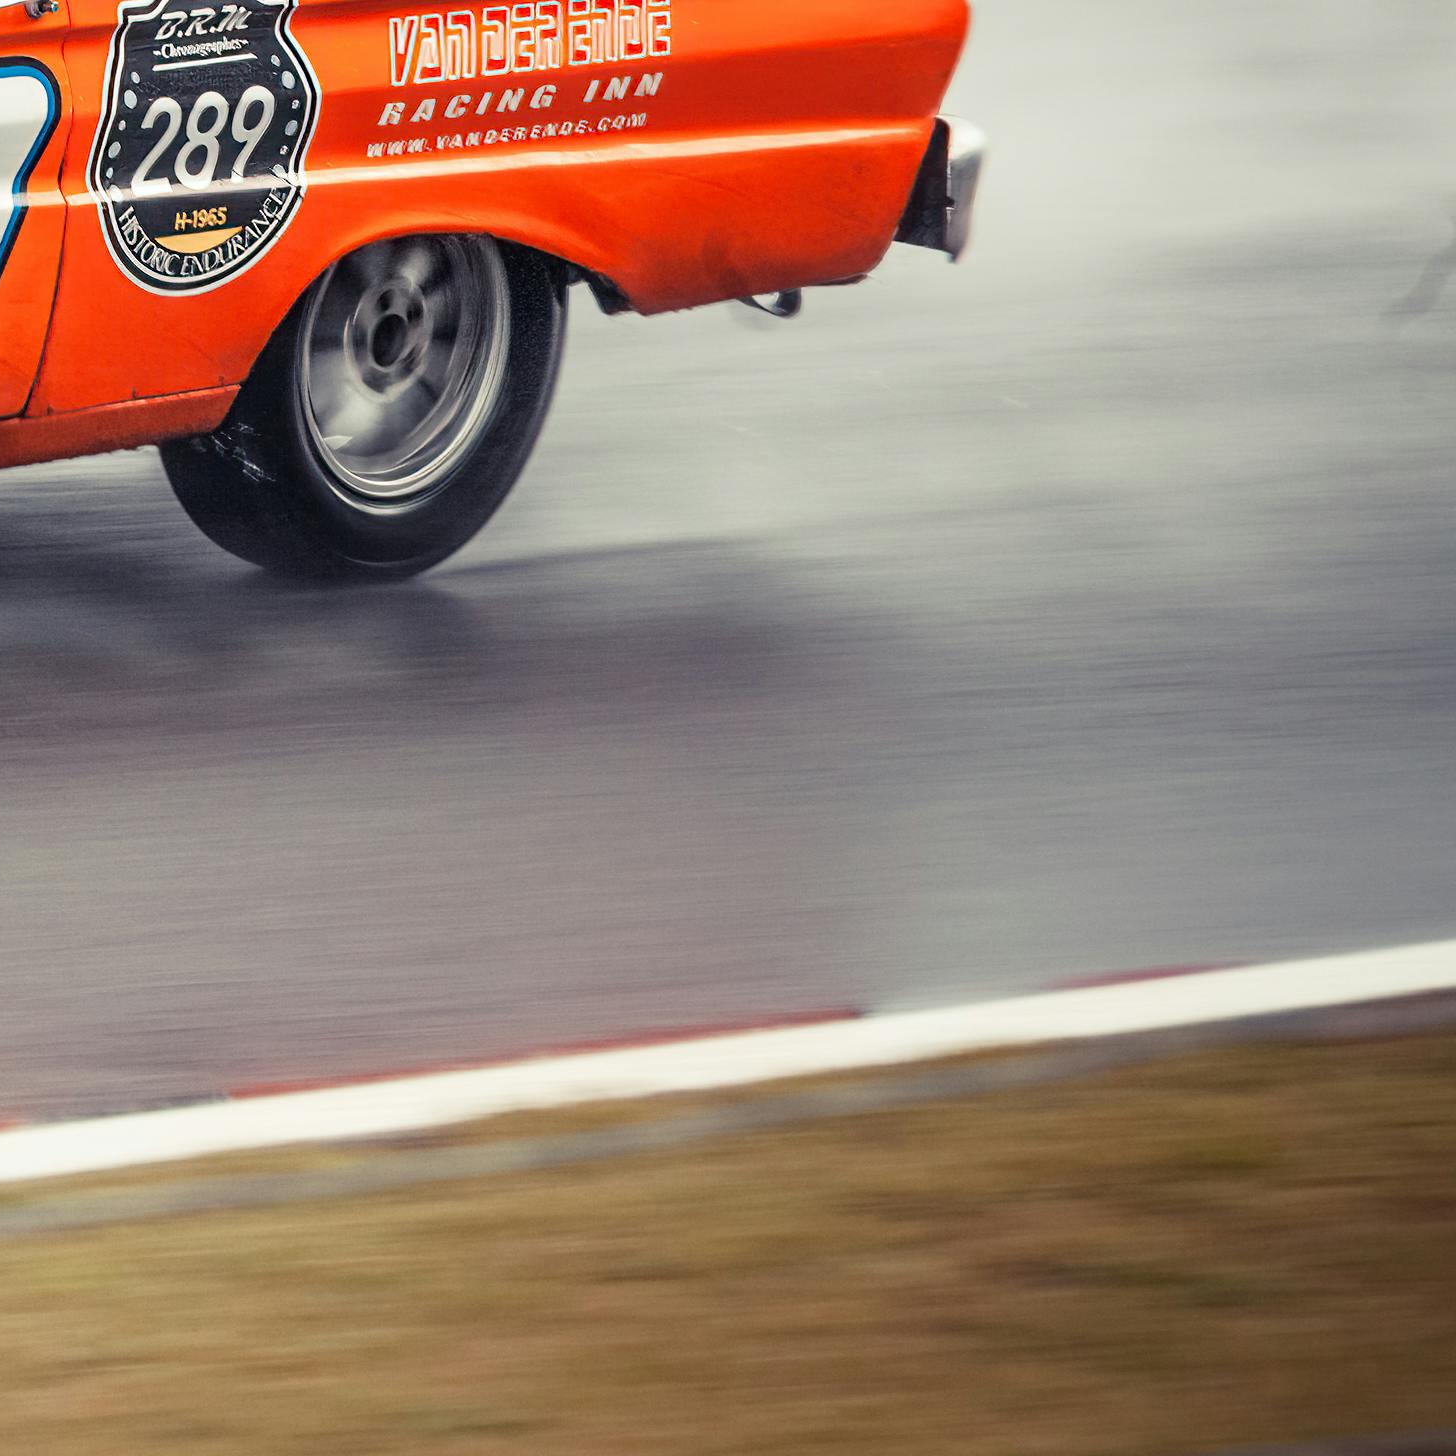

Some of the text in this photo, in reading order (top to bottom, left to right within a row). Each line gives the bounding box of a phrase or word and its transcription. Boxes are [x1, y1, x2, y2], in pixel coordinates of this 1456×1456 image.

[389, 9, 477, 87] VAN
[480, 0, 563, 77] DER
[377, 72, 664, 126] RACING INN
[130, 85, 276, 194] 289
[366, 112, 647, 158] WWW.VANDERENDE.COM
[118, 186, 286, 276] HISTORIC ENDURANCE
[174, 206, 228, 231] H-1965
